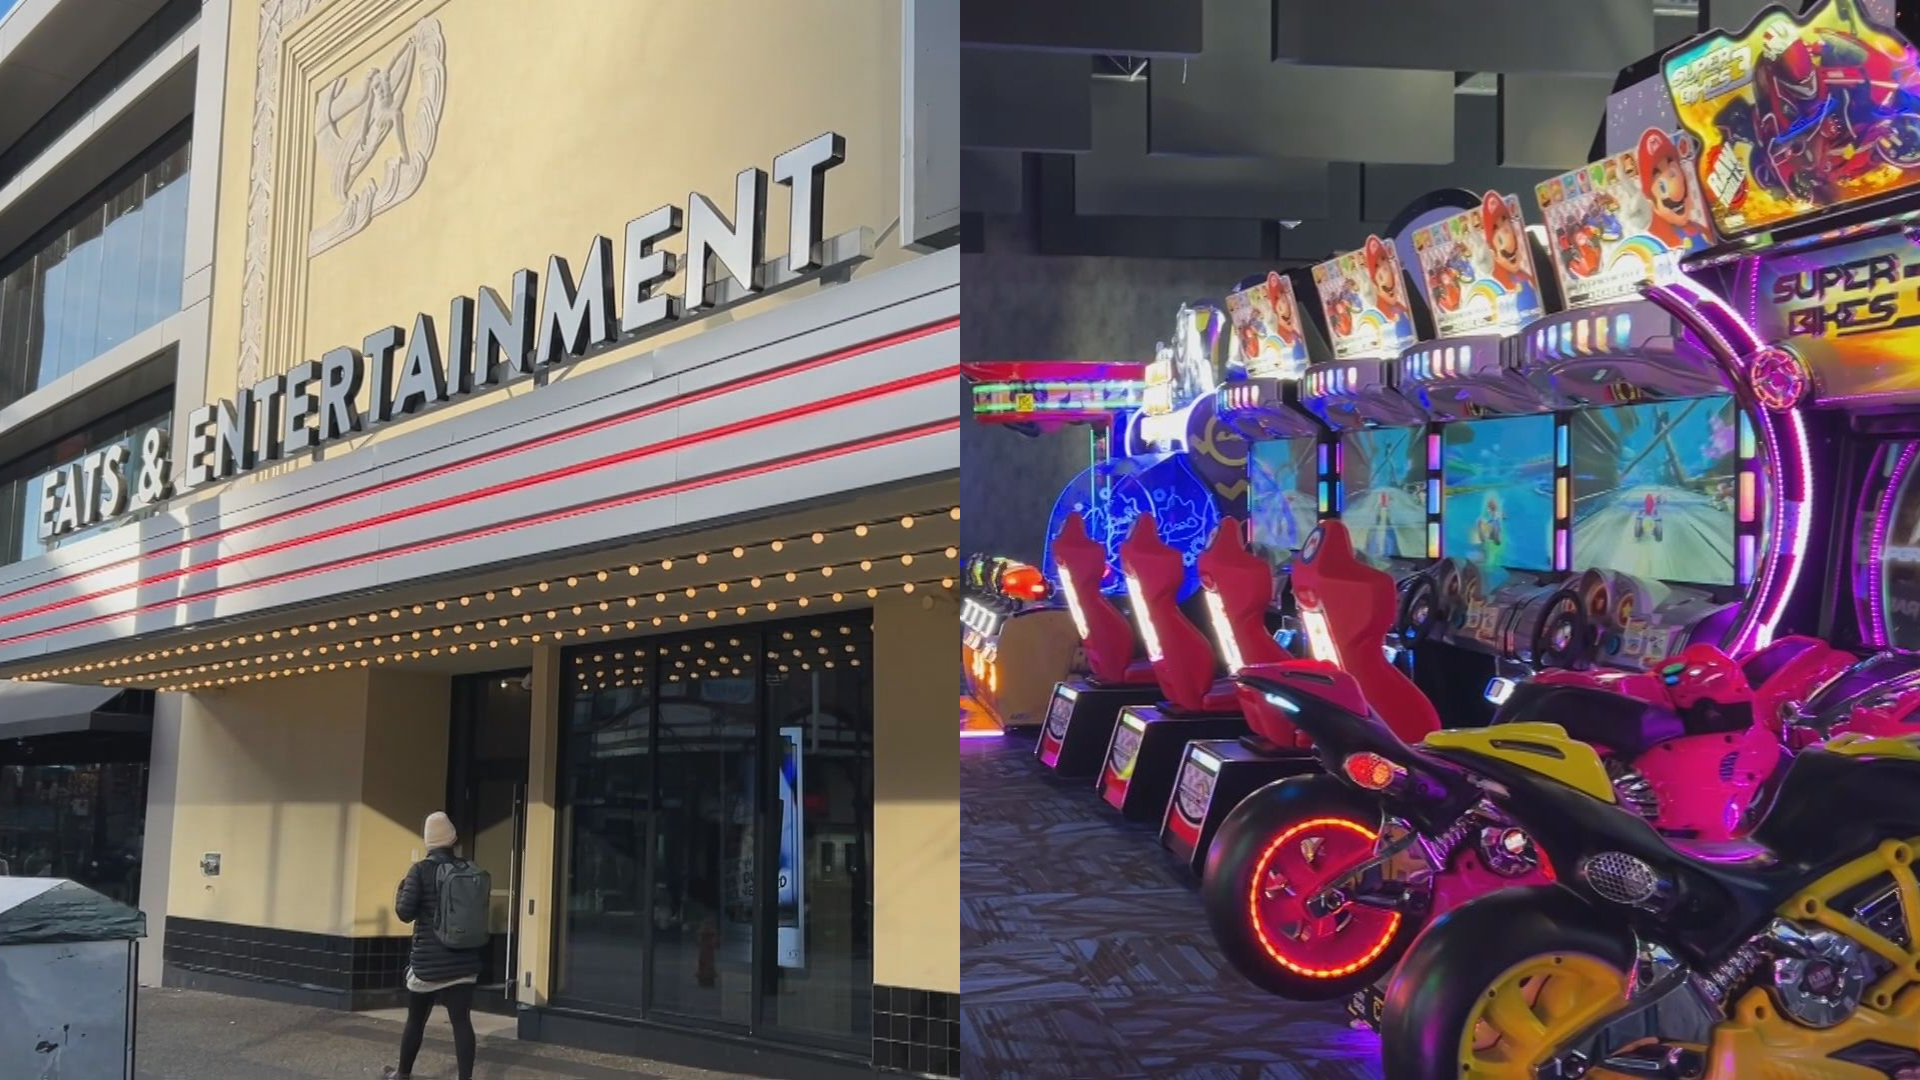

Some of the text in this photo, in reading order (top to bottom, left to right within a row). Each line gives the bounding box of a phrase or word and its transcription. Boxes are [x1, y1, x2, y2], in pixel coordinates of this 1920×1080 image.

[1772, 254, 1900, 304] SUPER
[38, 131, 845, 541] EATS & ENTERTAINMENT
[1788, 291, 1899, 338] BIKES
